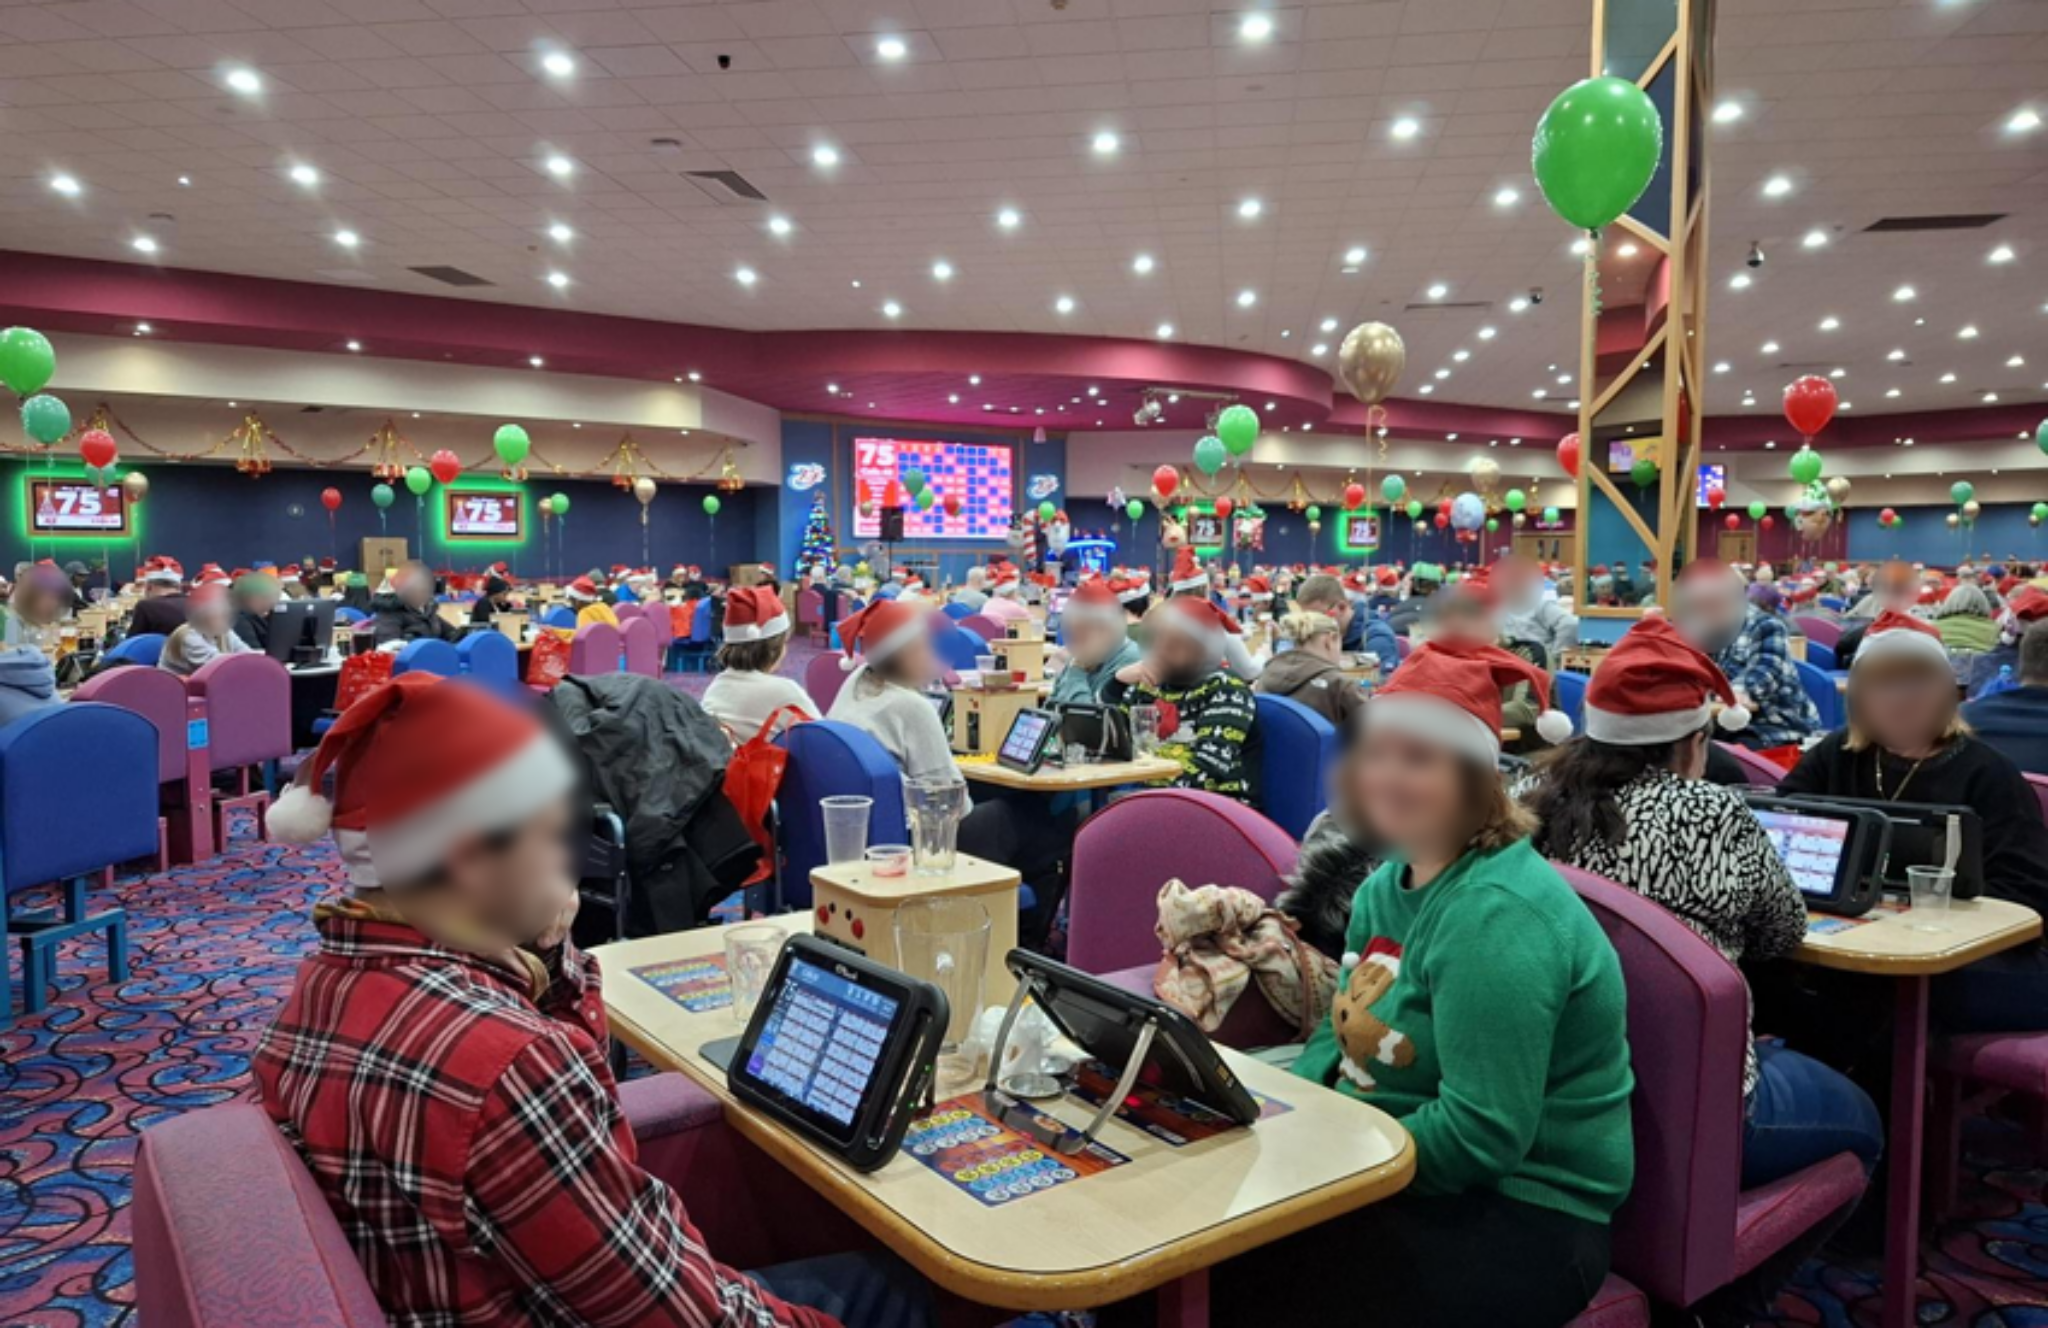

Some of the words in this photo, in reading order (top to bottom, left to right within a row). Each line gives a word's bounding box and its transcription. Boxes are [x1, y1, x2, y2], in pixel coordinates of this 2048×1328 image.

[859, 443, 894, 466] 75
[55, 491, 101, 515] 75
[465, 502, 502, 522] 75
